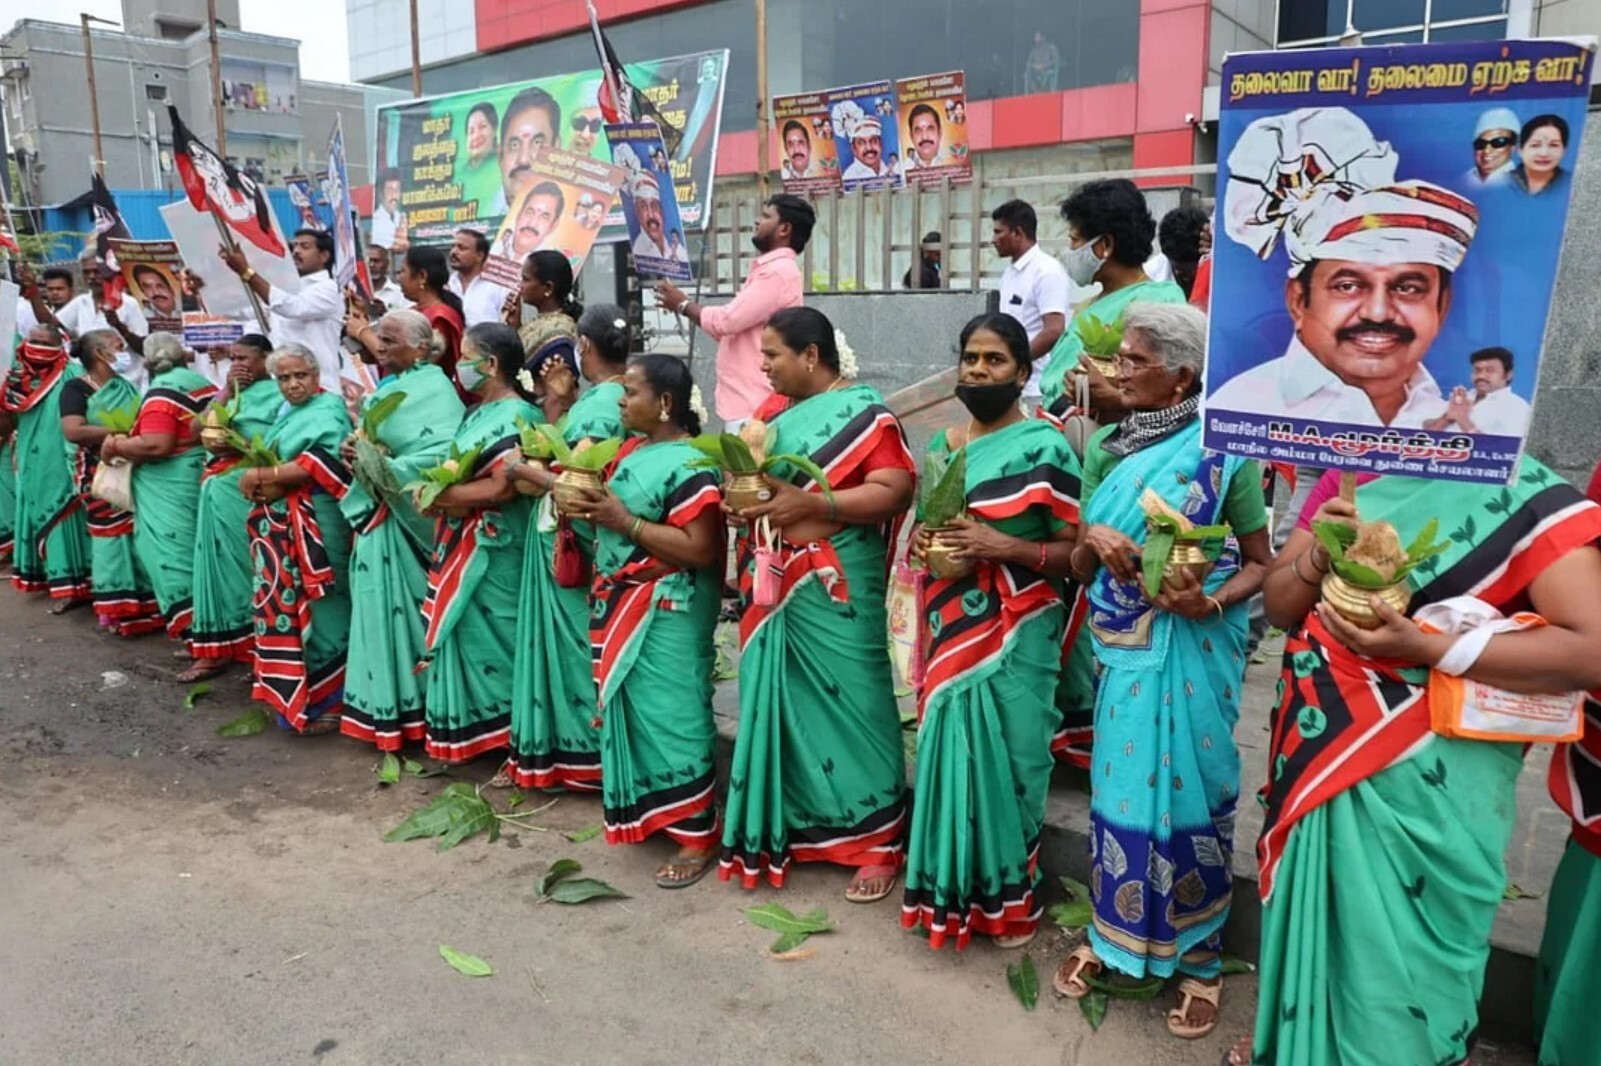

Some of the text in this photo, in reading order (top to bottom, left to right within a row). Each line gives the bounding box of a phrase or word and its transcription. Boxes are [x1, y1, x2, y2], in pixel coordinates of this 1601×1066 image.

[1229, 46, 1588, 101] தலைவா வா! தலைமை ஏற்க வா!
